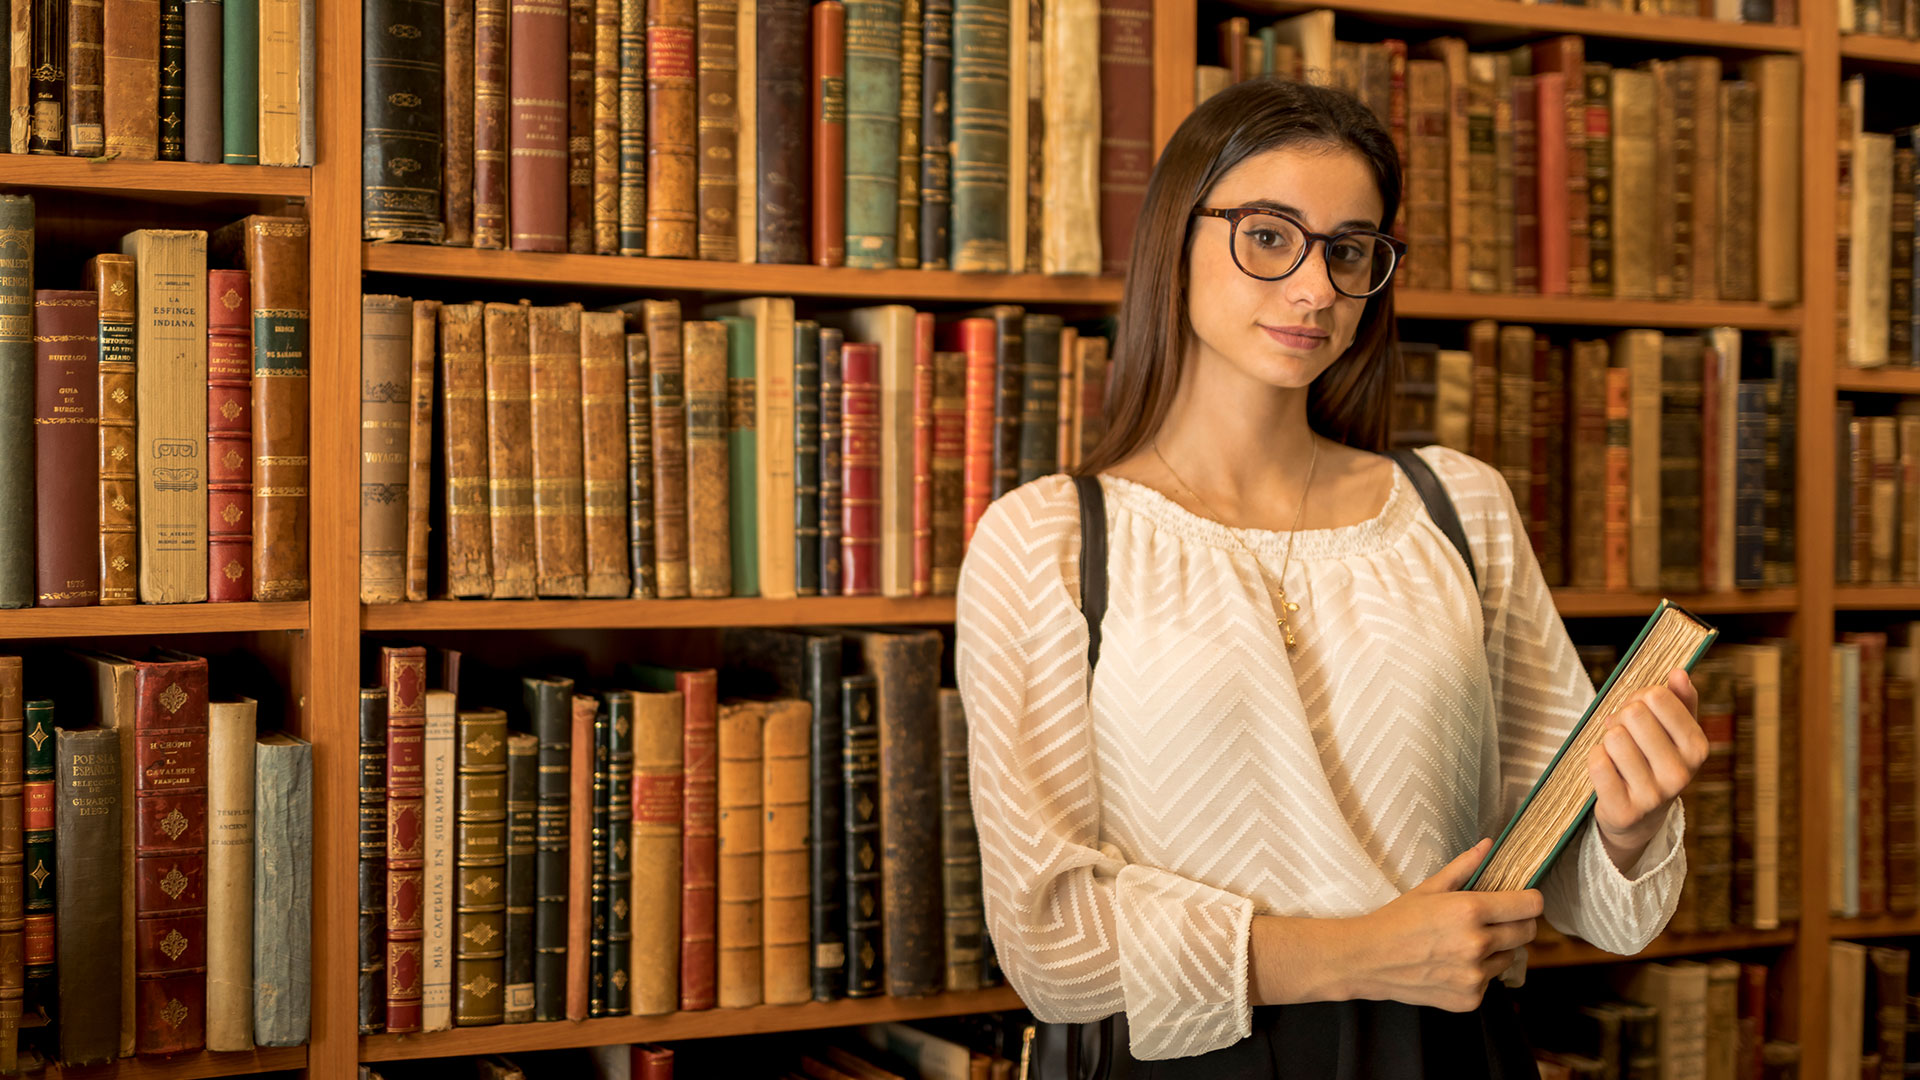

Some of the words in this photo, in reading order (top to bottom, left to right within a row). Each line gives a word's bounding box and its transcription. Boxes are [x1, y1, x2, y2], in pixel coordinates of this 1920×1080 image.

[153, 306, 196, 315] ESFINGE
[153, 319, 196, 328] INDIANA
[145, 767, 196, 777] CAVALERIE
[72, 797, 116, 806] GERARDO
[434, 754, 445, 841] SURAMÉRICA
[80, 807, 110, 816] DIEGO
[434, 848, 444, 867] EN
[432, 873, 444, 939] CACERÍAS
[433, 945, 443, 969] MIS
